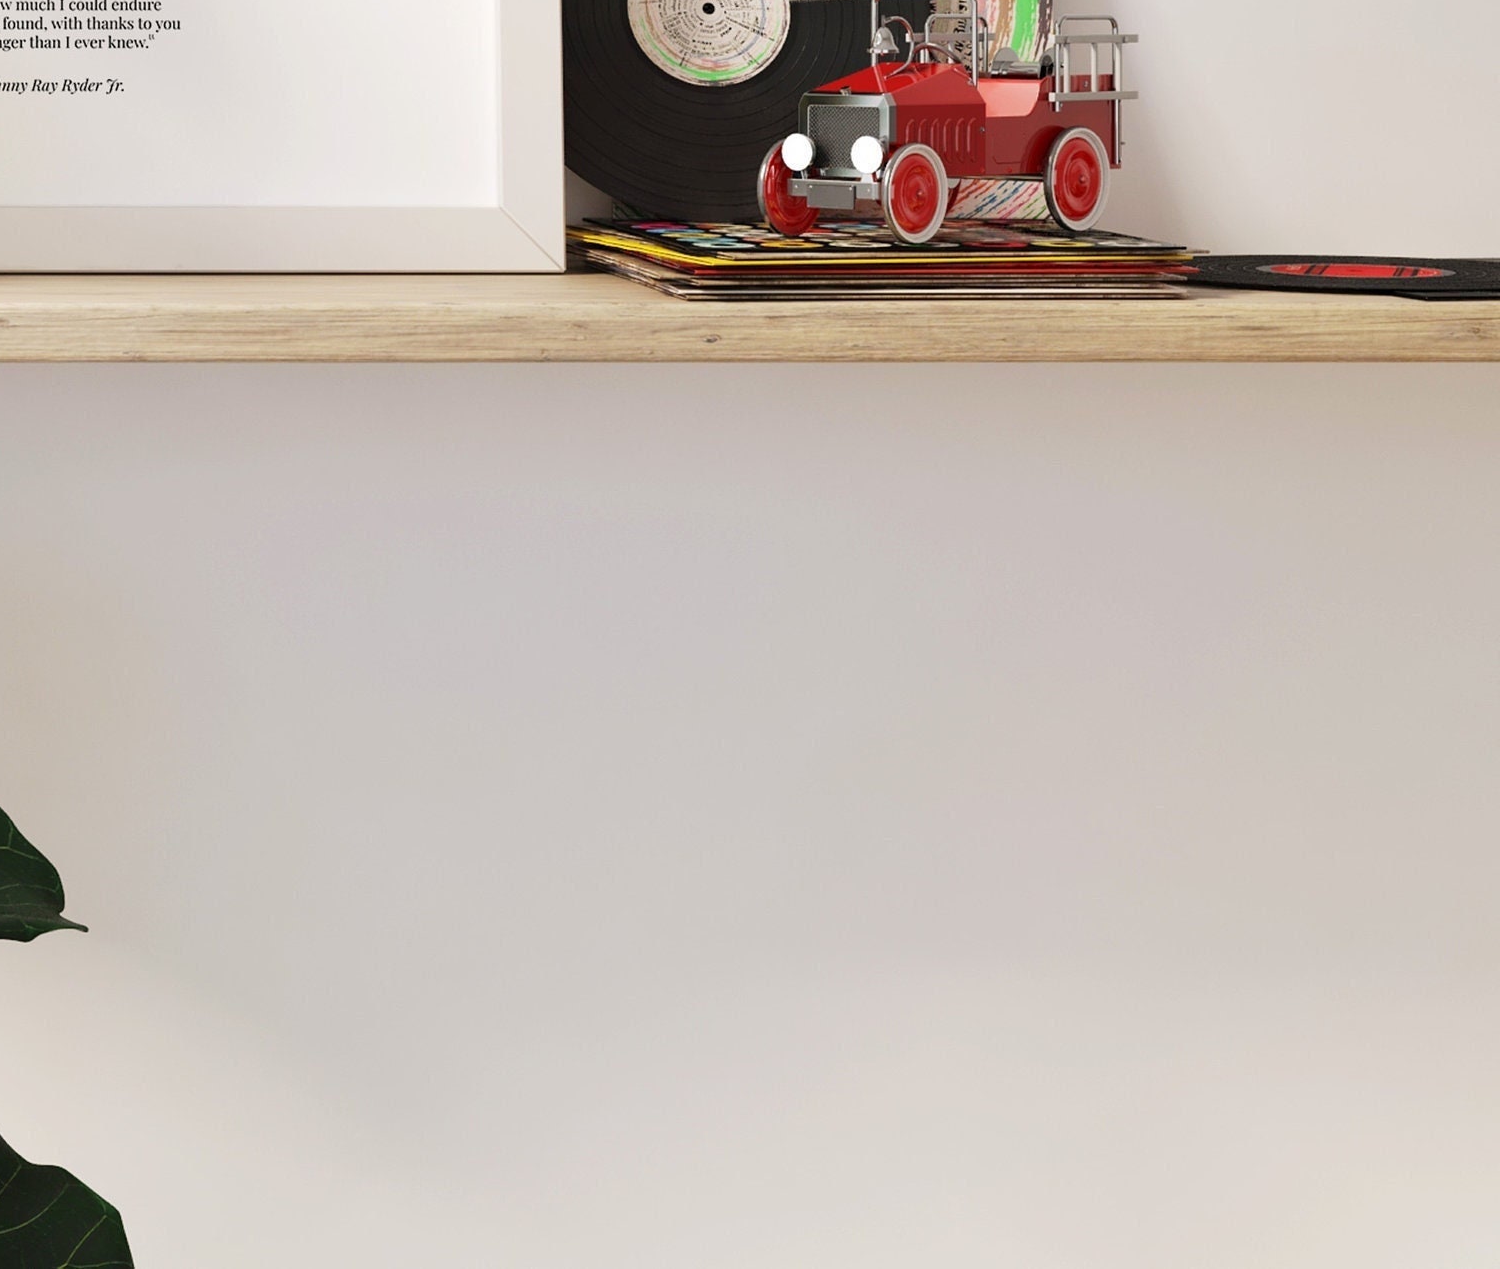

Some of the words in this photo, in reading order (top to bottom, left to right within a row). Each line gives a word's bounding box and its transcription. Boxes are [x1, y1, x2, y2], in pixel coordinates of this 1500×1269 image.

[2, 16, 48, 31] found,
[50, 16, 83, 31] with
[86, 15, 135, 31] thanks
[137, 17, 153, 31] to
[155, 19, 181, 33] you
[29, 34, 61, 49] than
[65, 35, 70, 49] I
[74, 38, 106, 50] ever
[31, 78, 59, 95] Ray
[61, 77, 103, 95] Ryder
[105, 78, 125, 95] Jr.
